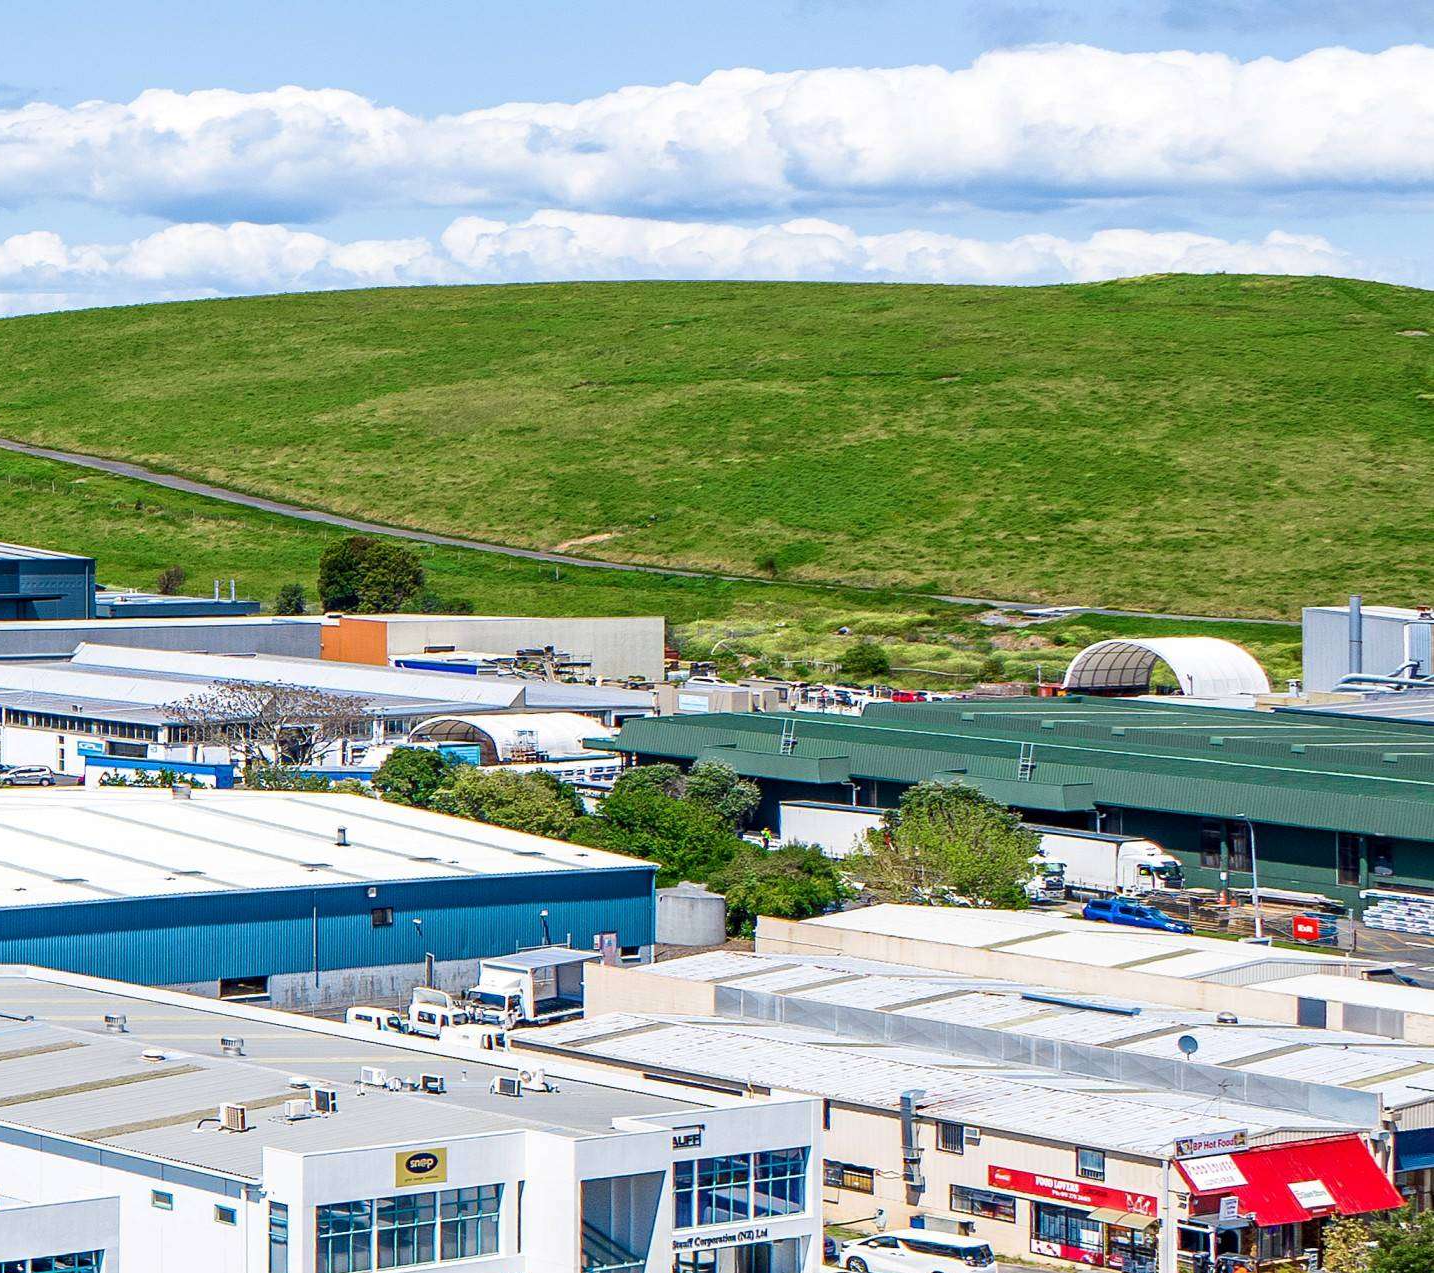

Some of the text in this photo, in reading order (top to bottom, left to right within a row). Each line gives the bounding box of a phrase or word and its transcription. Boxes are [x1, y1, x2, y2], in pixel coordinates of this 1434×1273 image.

[673, 1134, 699, 1148] AUFF
[694, 1233, 736, 1247] Corporation
[738, 1230, 755, 1242] (NZ)
[756, 1228, 768, 1238] Ltd
